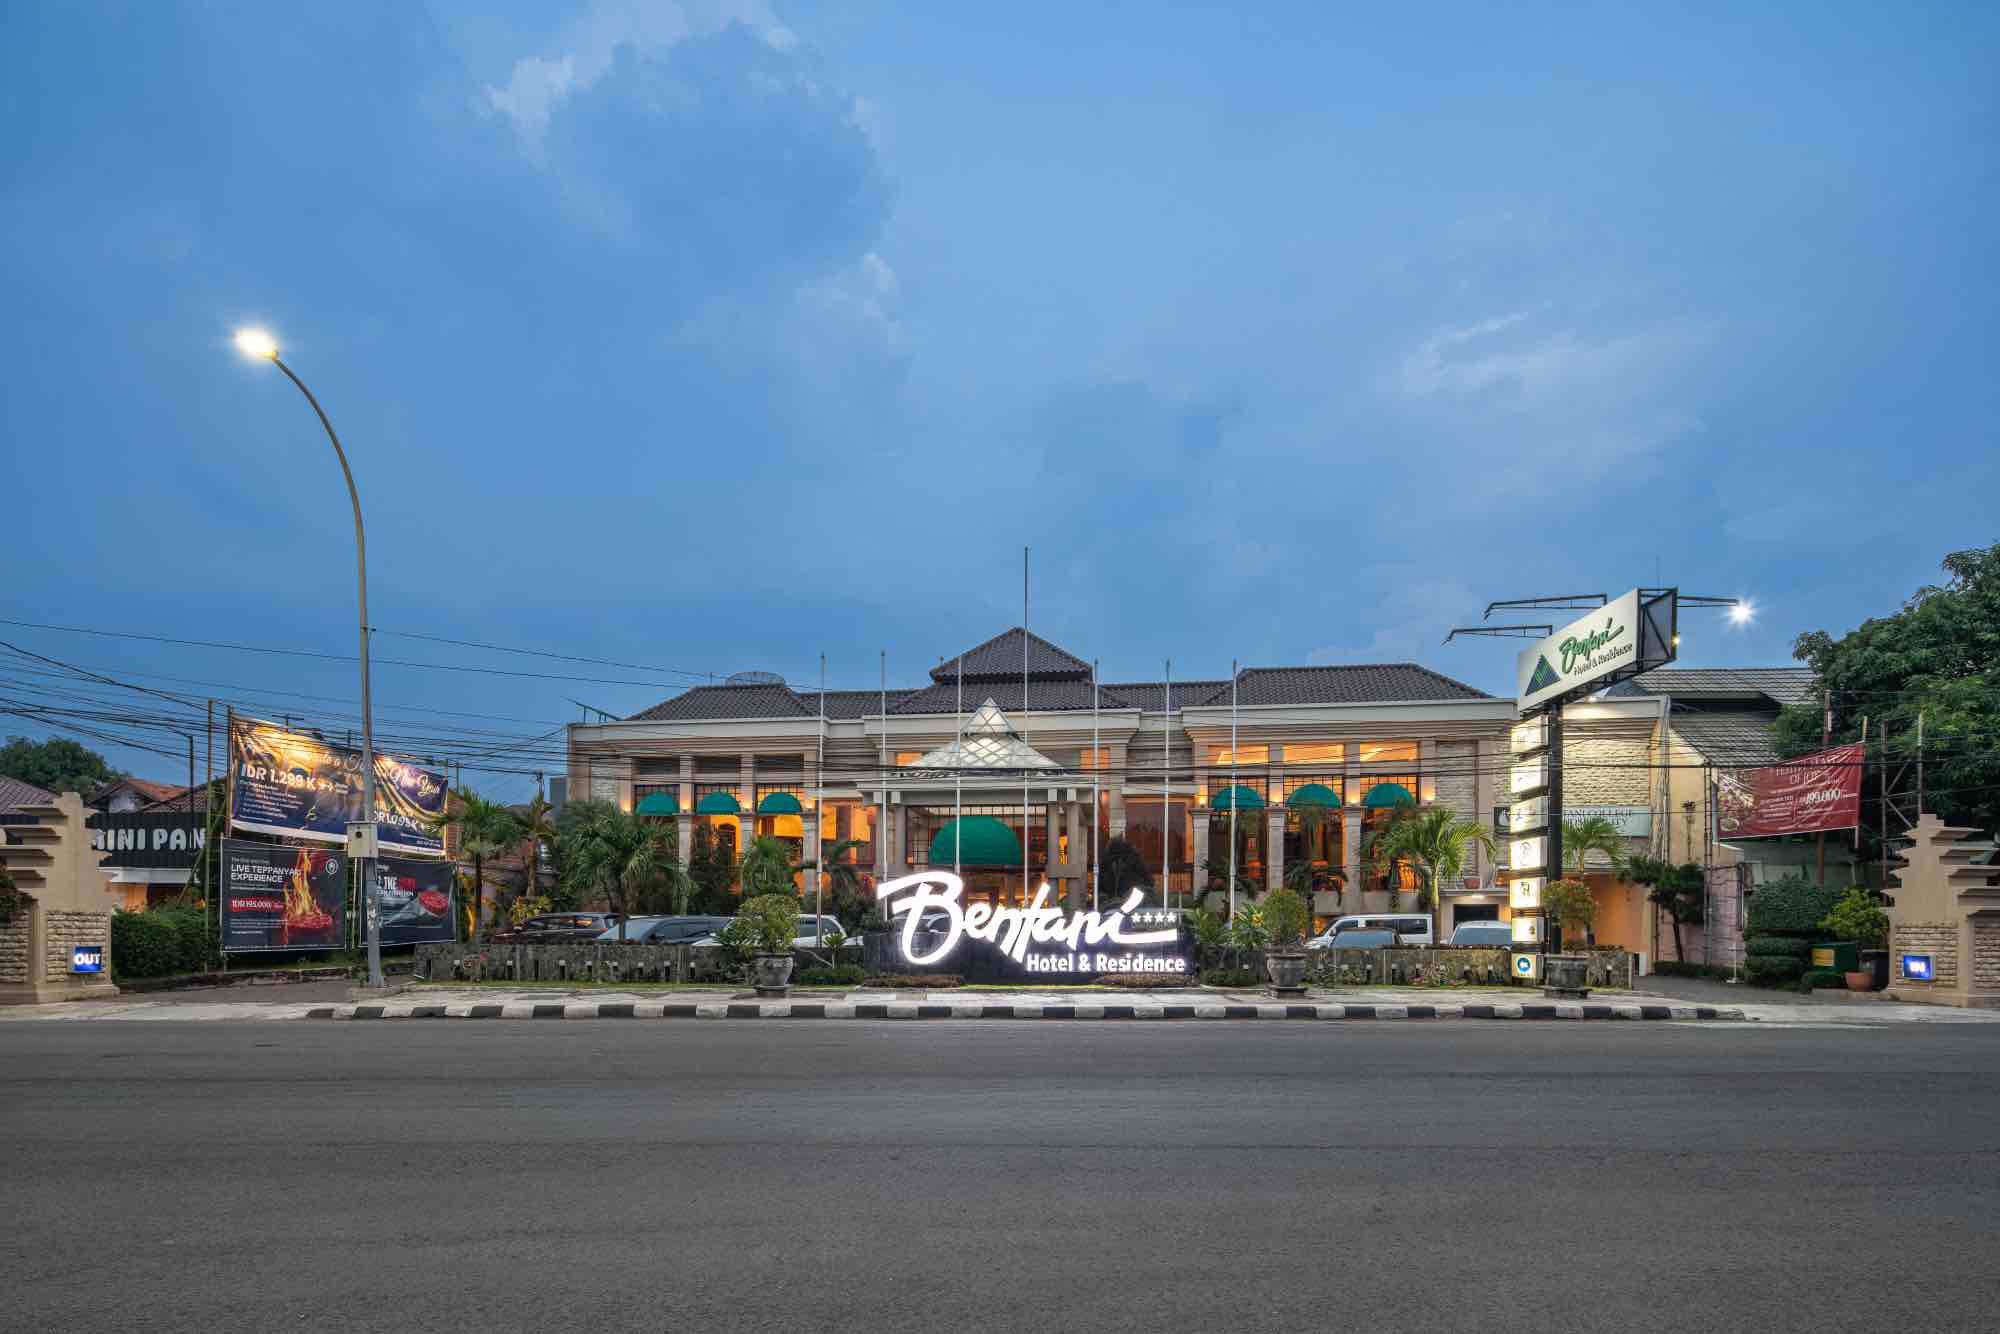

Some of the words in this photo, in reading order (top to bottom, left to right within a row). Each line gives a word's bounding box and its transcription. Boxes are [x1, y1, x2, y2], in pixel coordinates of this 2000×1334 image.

[241, 763, 267, 780] IDR
[231, 864, 250, 873] LIVE
[231, 872, 284, 883] EXPERIENCE
[877, 871, 1178, 965] Bentani
[74, 953, 101, 966] OUT
[1026, 953, 1073, 973] Hotel
[1079, 955, 1091, 972] &
[1096, 953, 1186, 973] Residence
